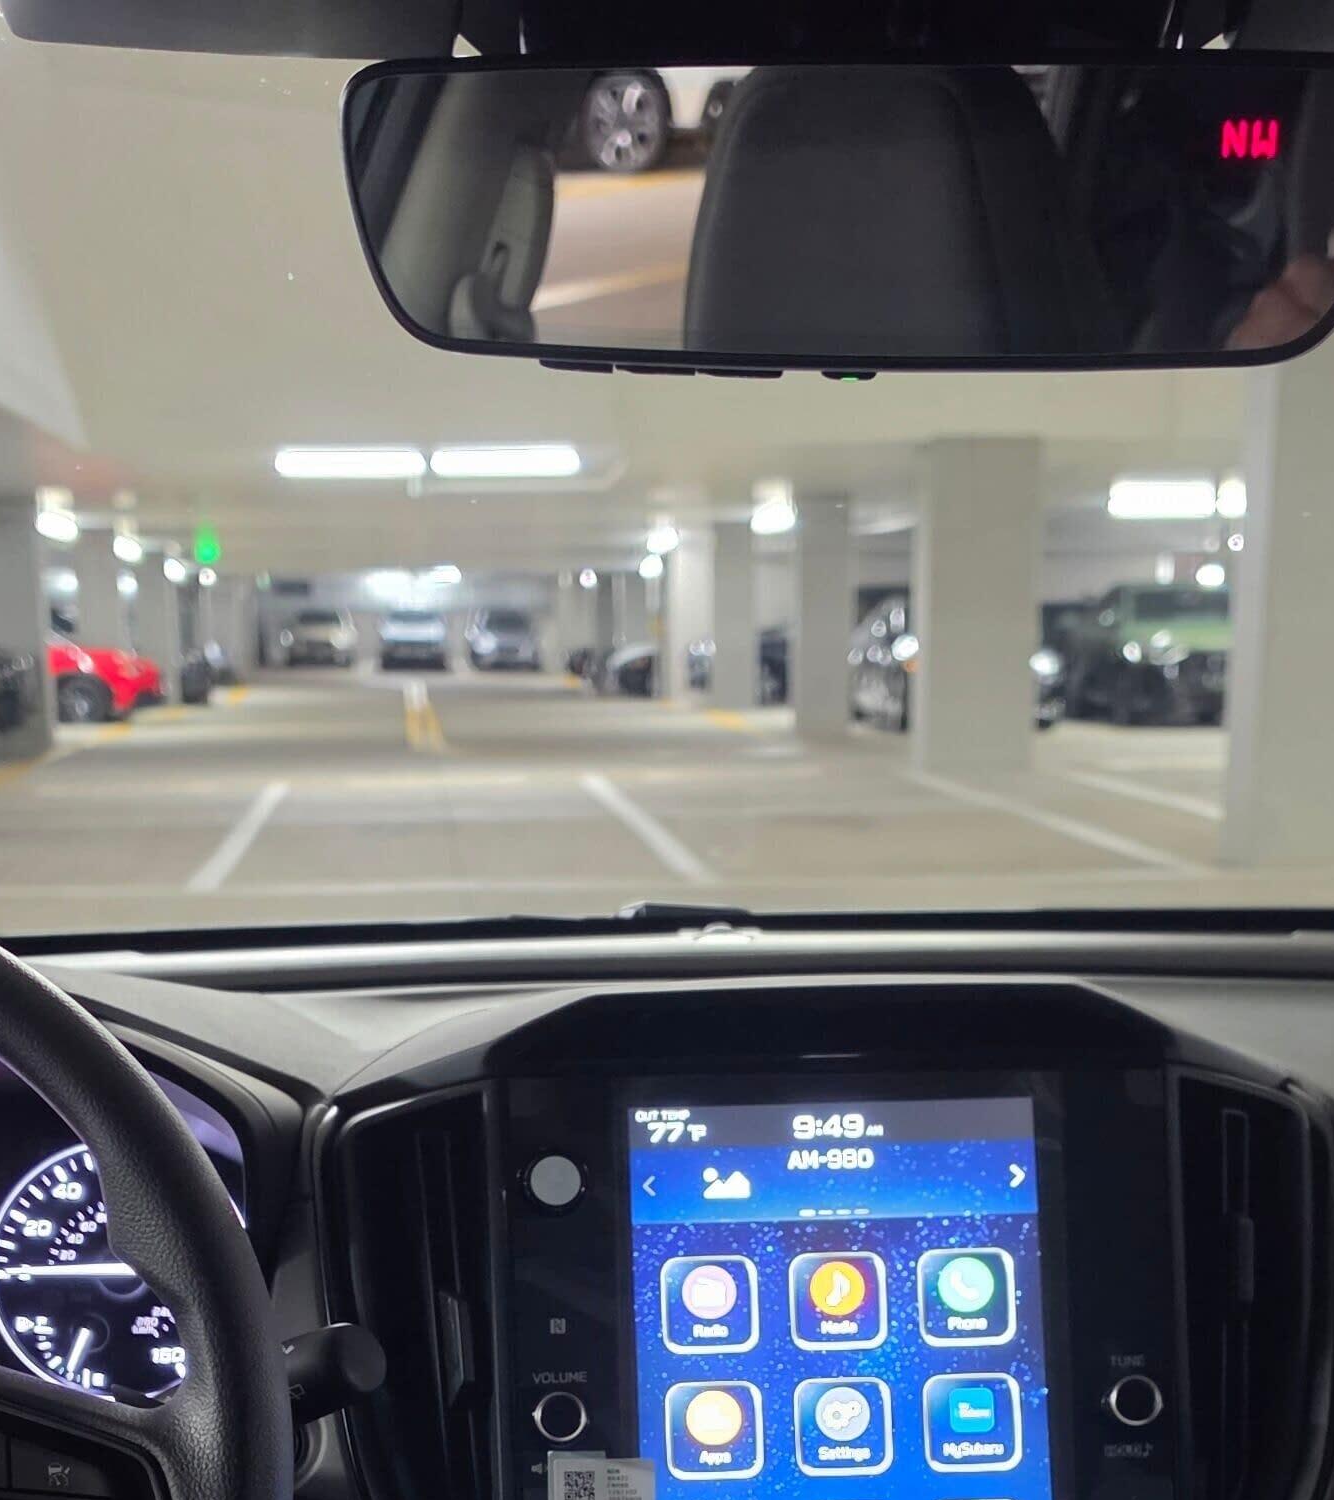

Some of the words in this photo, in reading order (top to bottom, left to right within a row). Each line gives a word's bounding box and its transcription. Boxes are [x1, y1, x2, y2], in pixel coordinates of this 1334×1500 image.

[1221, 118, 1278, 158] NW
[647, 1121, 684, 1143] 77
[792, 1113, 864, 1139] 9:49
[787, 1147, 875, 1170] AM-980
[51, 1181, 83, 1200] 40
[22, 1219, 53, 1238] 20
[692, 1323, 729, 1338] Radio
[820, 1320, 859, 1335] Media
[947, 1316, 988, 1331] Phone
[532, 1371, 588, 1385] VOLUME
[698, 1451, 733, 1466] Apps
[818, 1445, 871, 1462] Settings
[942, 1441, 1005, 1459] MySubaru
